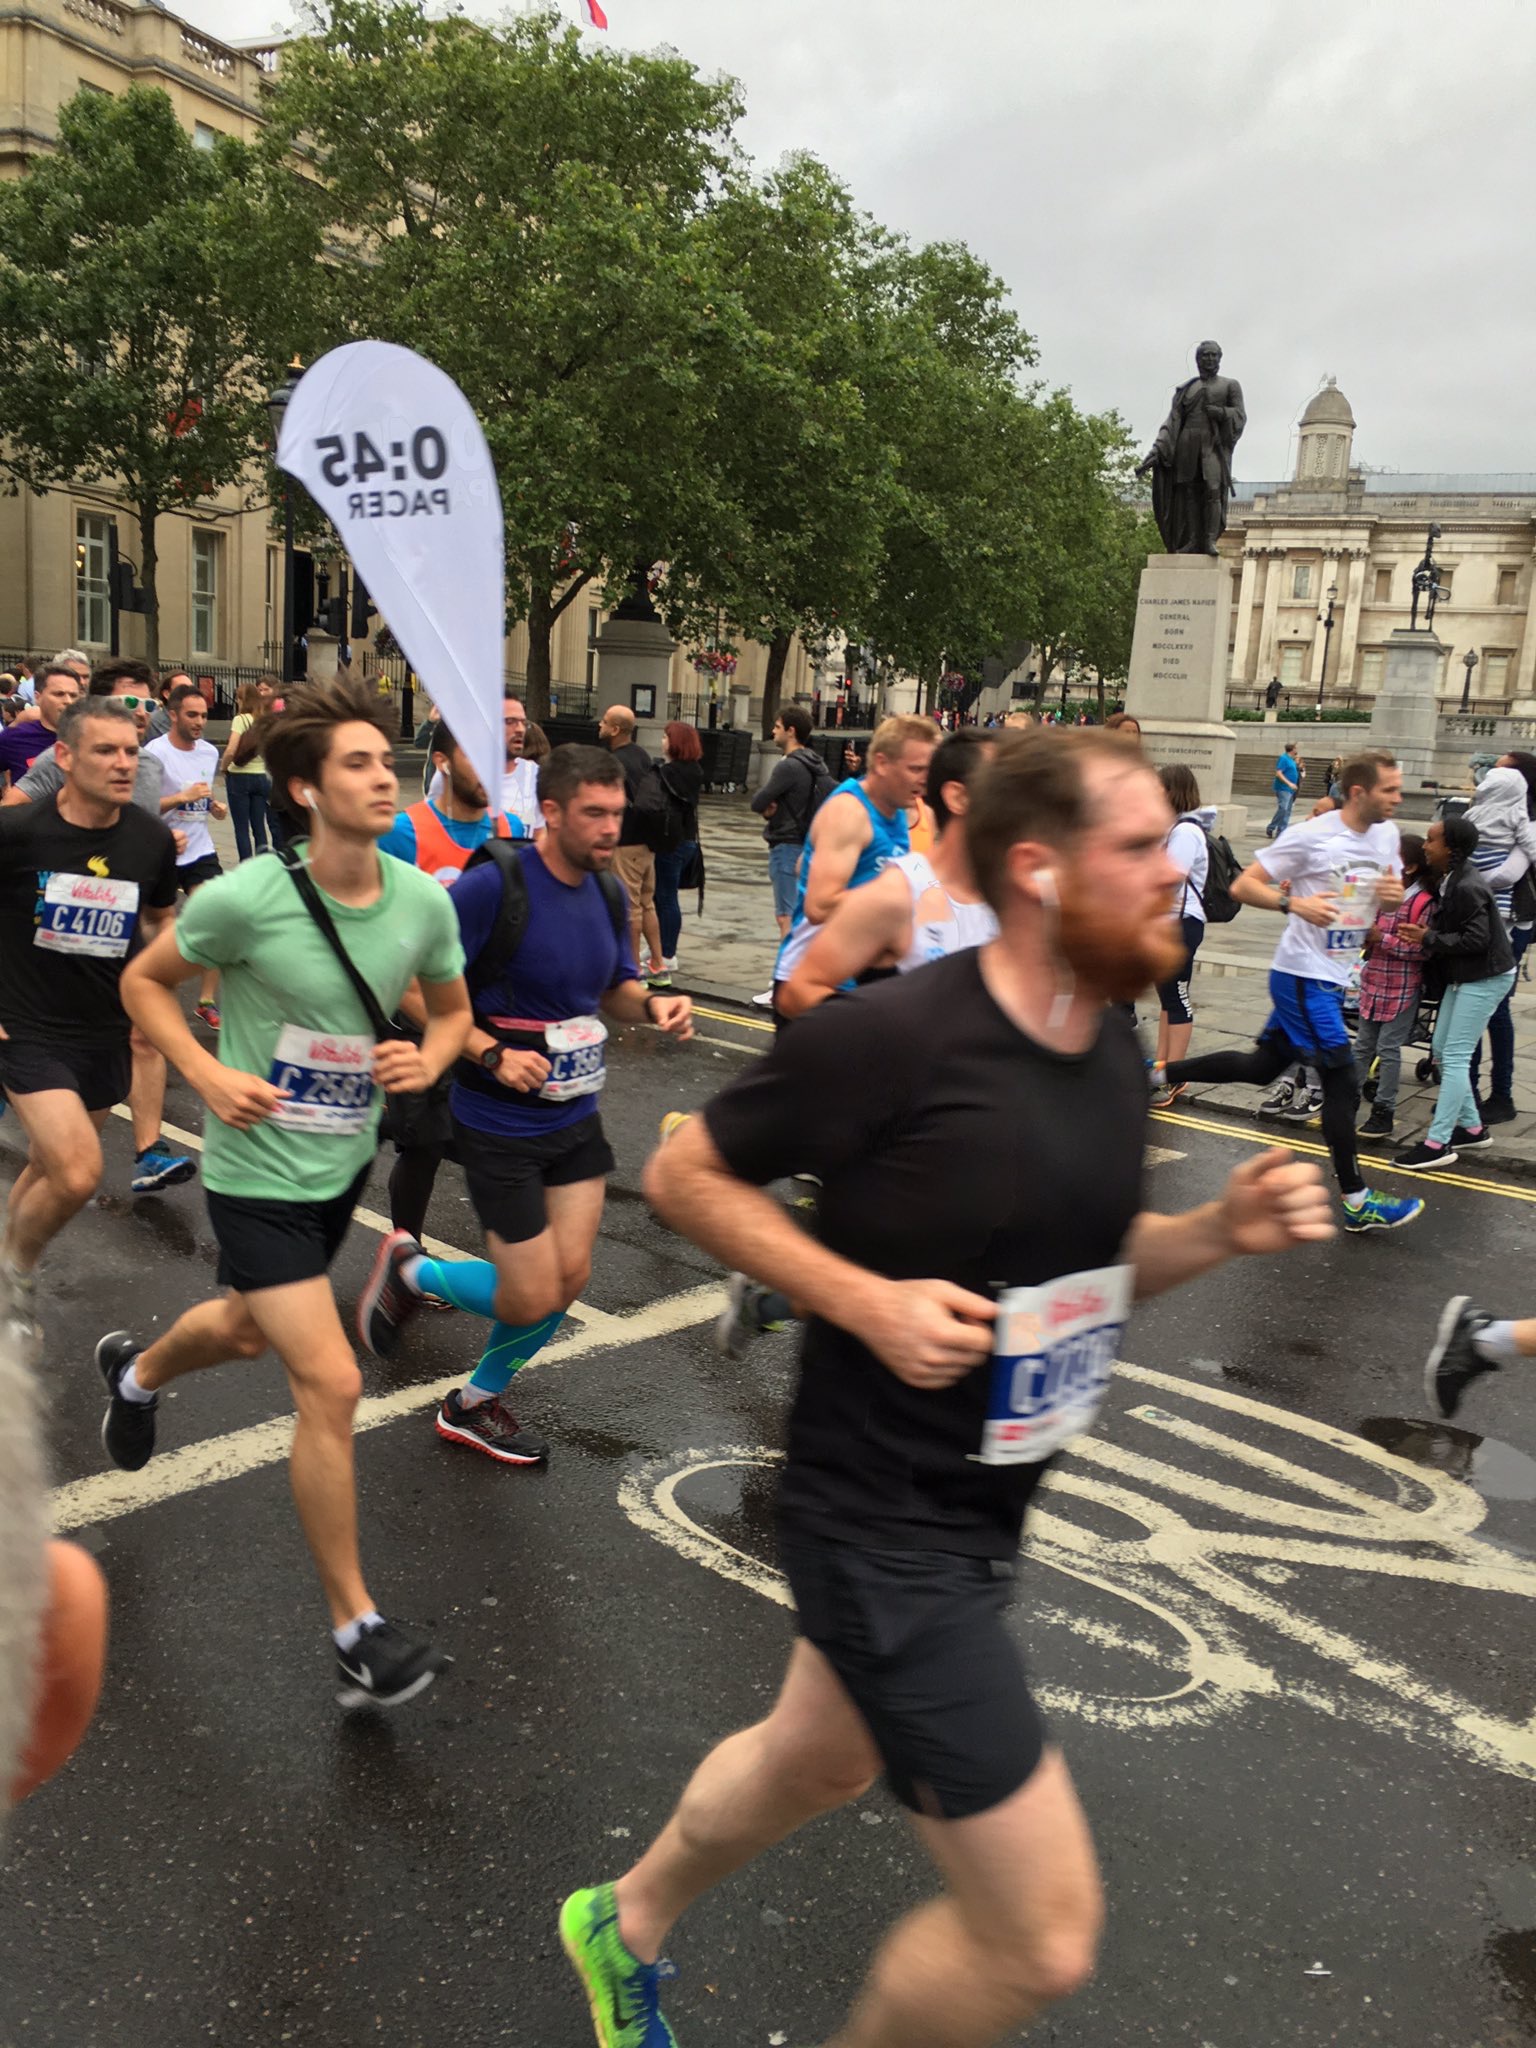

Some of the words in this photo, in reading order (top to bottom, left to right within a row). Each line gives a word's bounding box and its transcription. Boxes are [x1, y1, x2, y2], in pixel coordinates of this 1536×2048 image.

[1159, 613, 1190, 621] GENERAL
[1163, 657, 1180, 665] DIED
[51, 906, 69, 931] C
[71, 908, 126, 938] 4106
[553, 1055, 568, 1079] C
[279, 1065, 303, 1097] C
